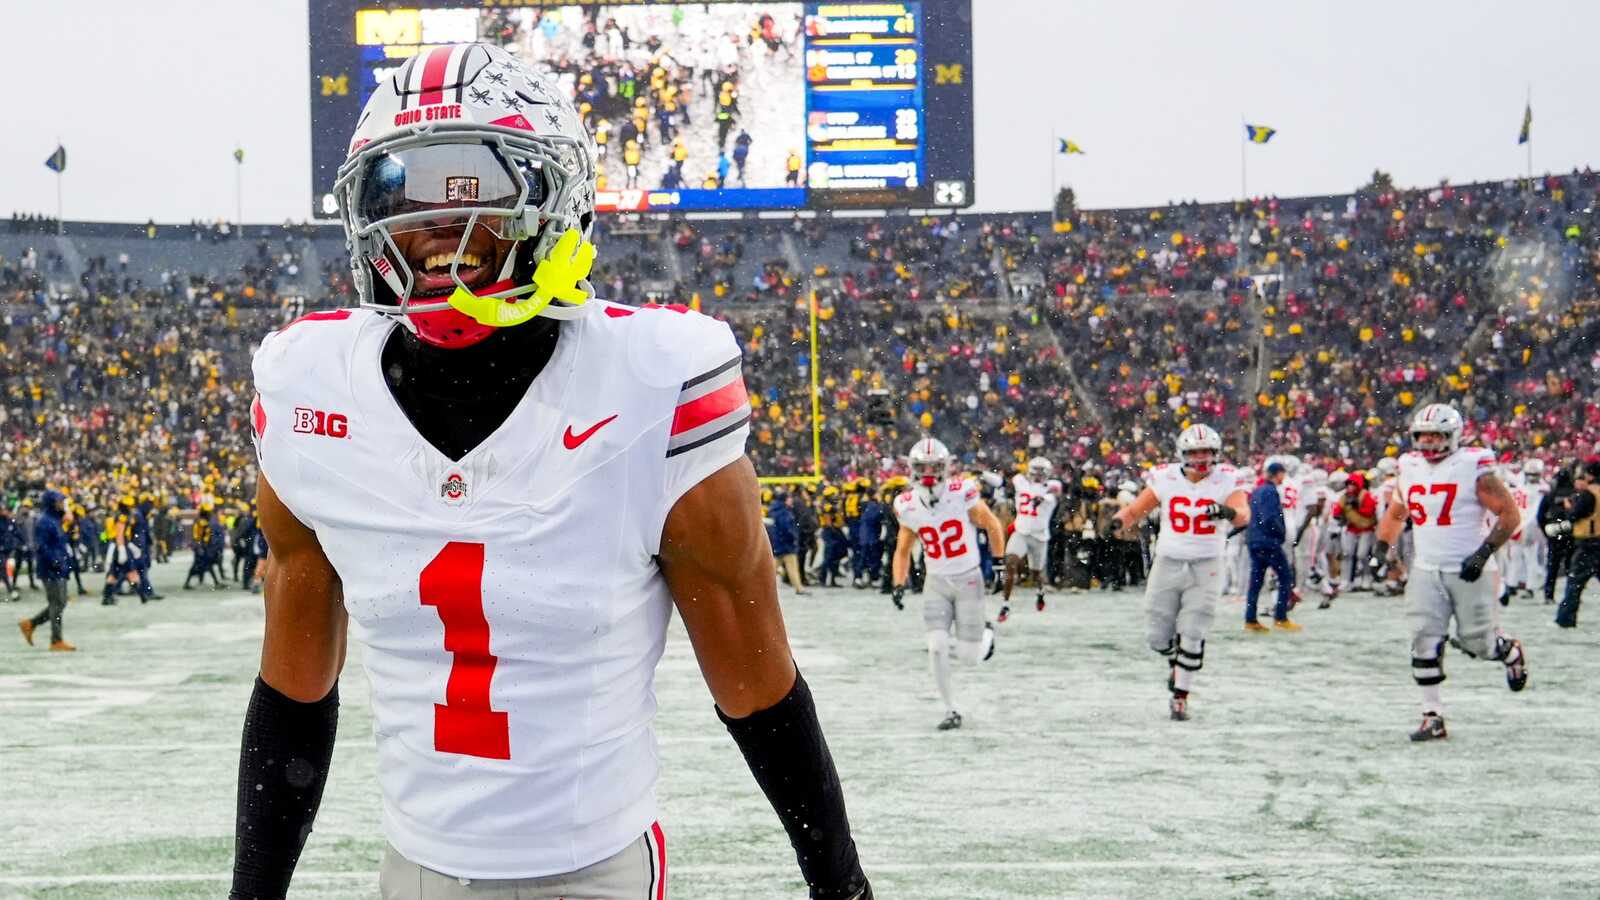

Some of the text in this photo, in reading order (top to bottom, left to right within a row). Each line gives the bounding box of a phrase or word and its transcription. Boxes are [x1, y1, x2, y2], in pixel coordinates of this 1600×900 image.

[320, 74, 348, 96] M
[934, 64, 962, 85] M
[394, 104, 462, 127] OHIO STATE
[1168, 496, 1217, 535] 62
[1407, 483, 1458, 526] 67
[917, 519, 967, 560] 82
[419, 541, 511, 760] 1
